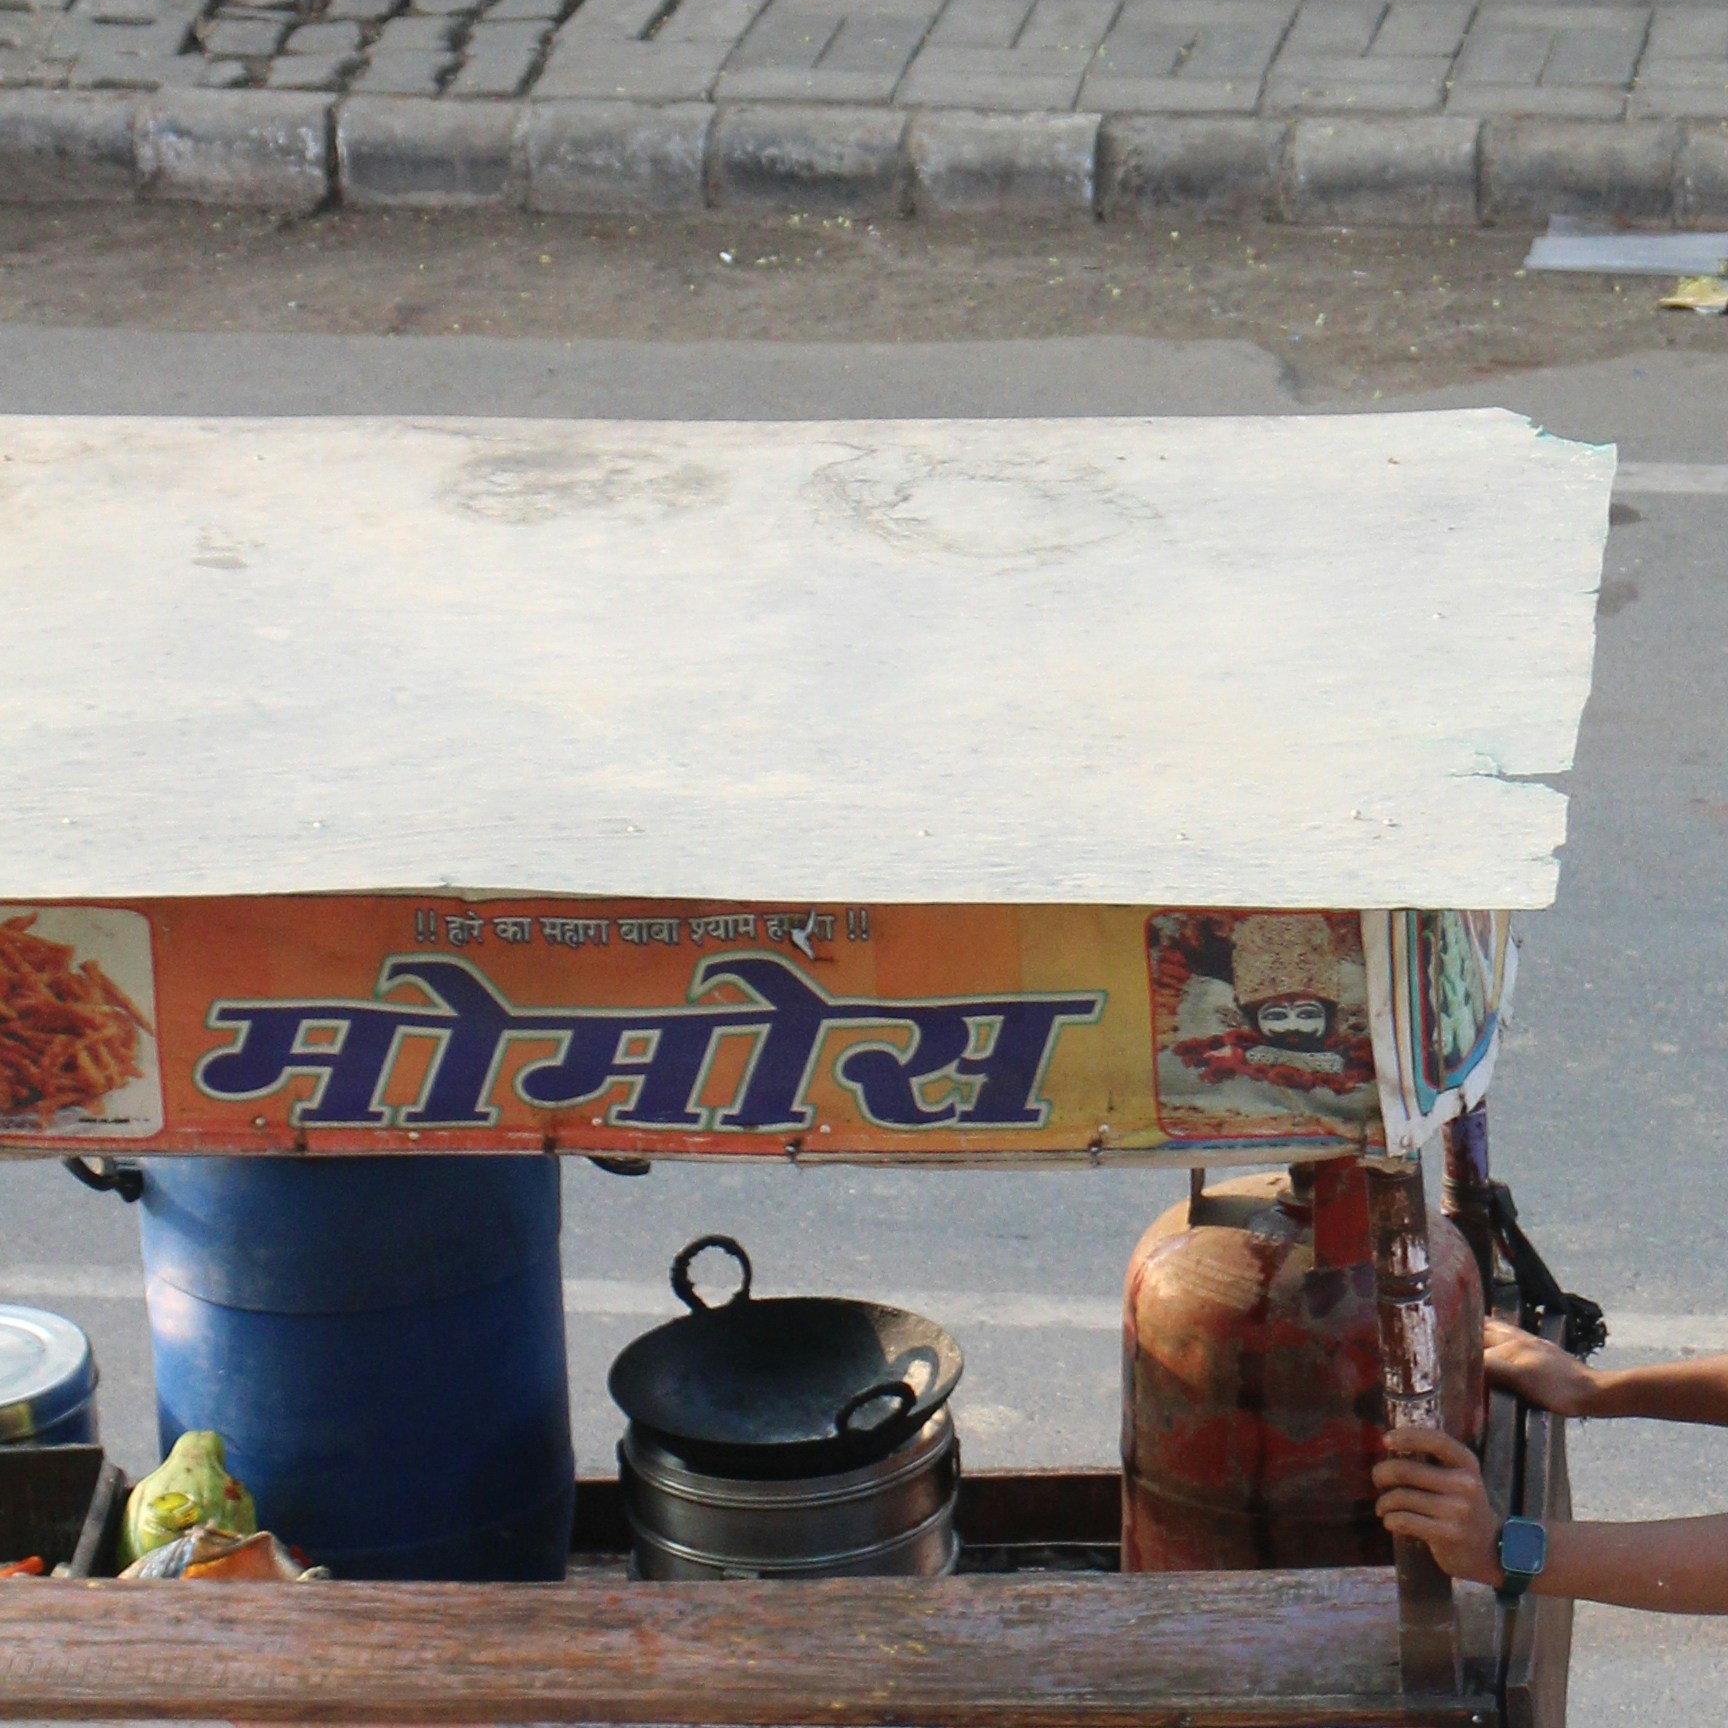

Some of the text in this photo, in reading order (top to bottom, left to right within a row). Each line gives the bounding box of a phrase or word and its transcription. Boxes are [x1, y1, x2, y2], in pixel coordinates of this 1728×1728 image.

[492, 916, 532, 944] का
[539, 916, 610, 948] सहारा
[617, 915, 681, 946] बाबा
[688, 913, 757, 947] श्याम
[193, 952, 1108, 1130] मोमोस
